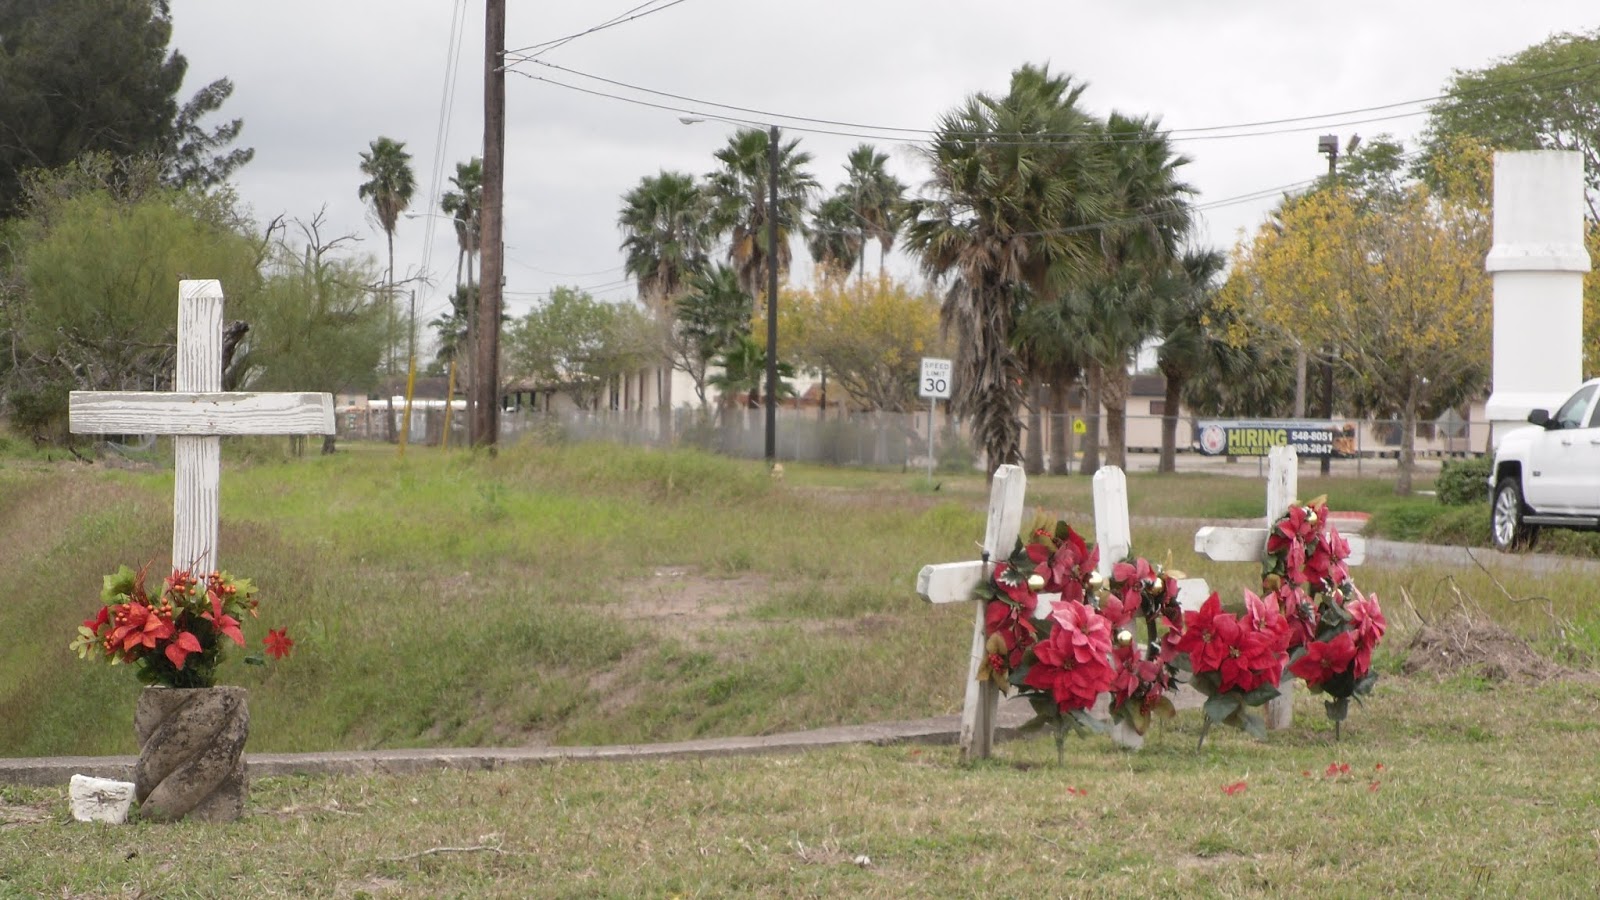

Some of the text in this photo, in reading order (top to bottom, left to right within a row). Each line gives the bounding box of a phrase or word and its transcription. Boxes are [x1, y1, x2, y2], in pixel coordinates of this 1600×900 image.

[925, 378, 946, 392] 30
[1229, 429, 1287, 446] HIRING
[1292, 431, 1333, 441] 548-8051
